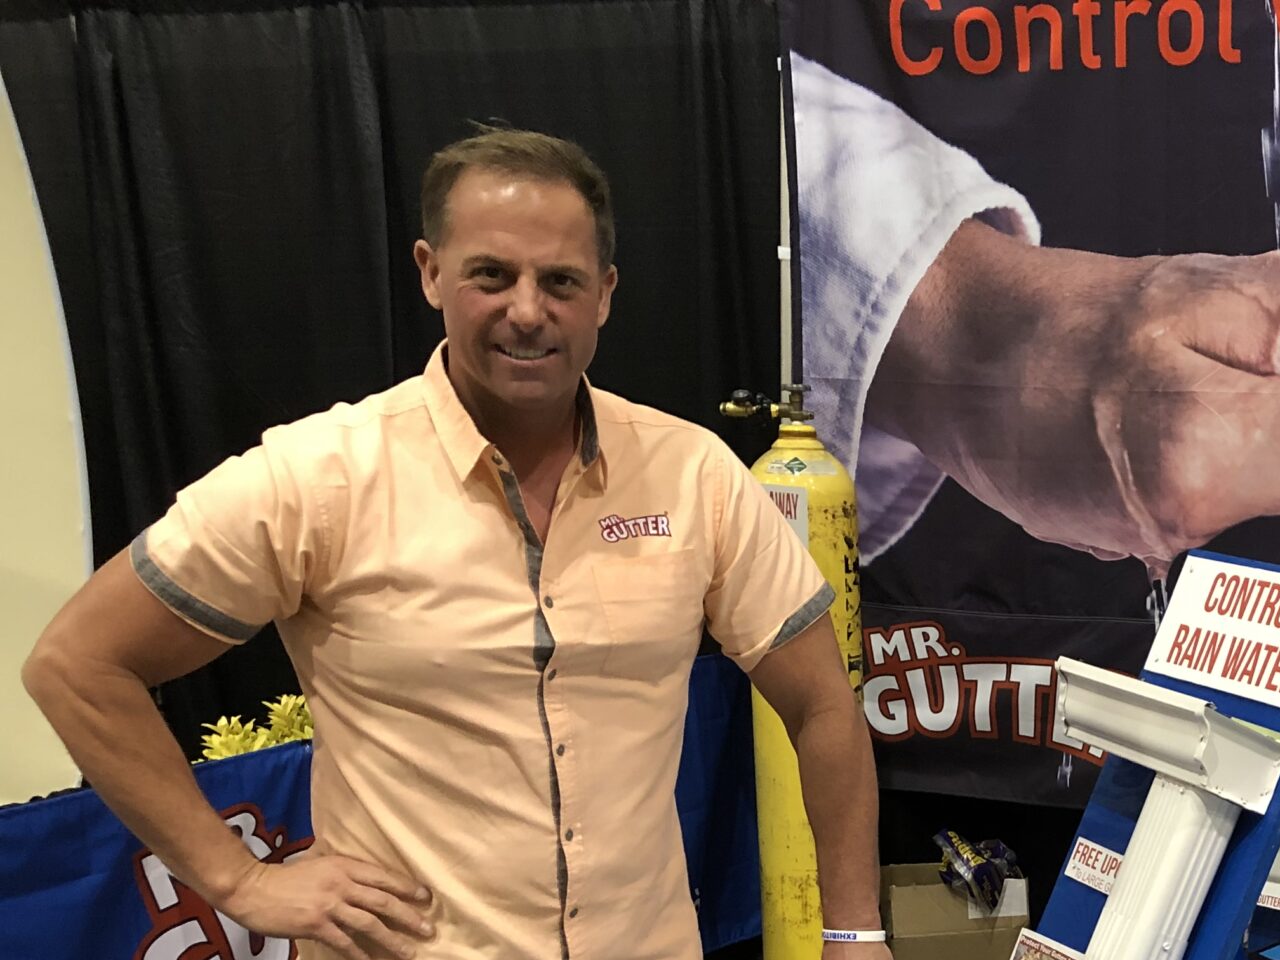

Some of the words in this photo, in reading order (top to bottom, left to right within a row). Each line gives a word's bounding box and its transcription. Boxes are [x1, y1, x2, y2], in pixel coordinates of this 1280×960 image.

[890, 0, 1240, 75] Control
[599, 515, 624, 530] MR.
[602, 515, 671, 543] GUTTER
[869, 626, 961, 665] MR.
[1166, 624, 1226, 674] RAIN
[863, 663, 1104, 758] GUTT
[1073, 842, 1103, 870] FREE
